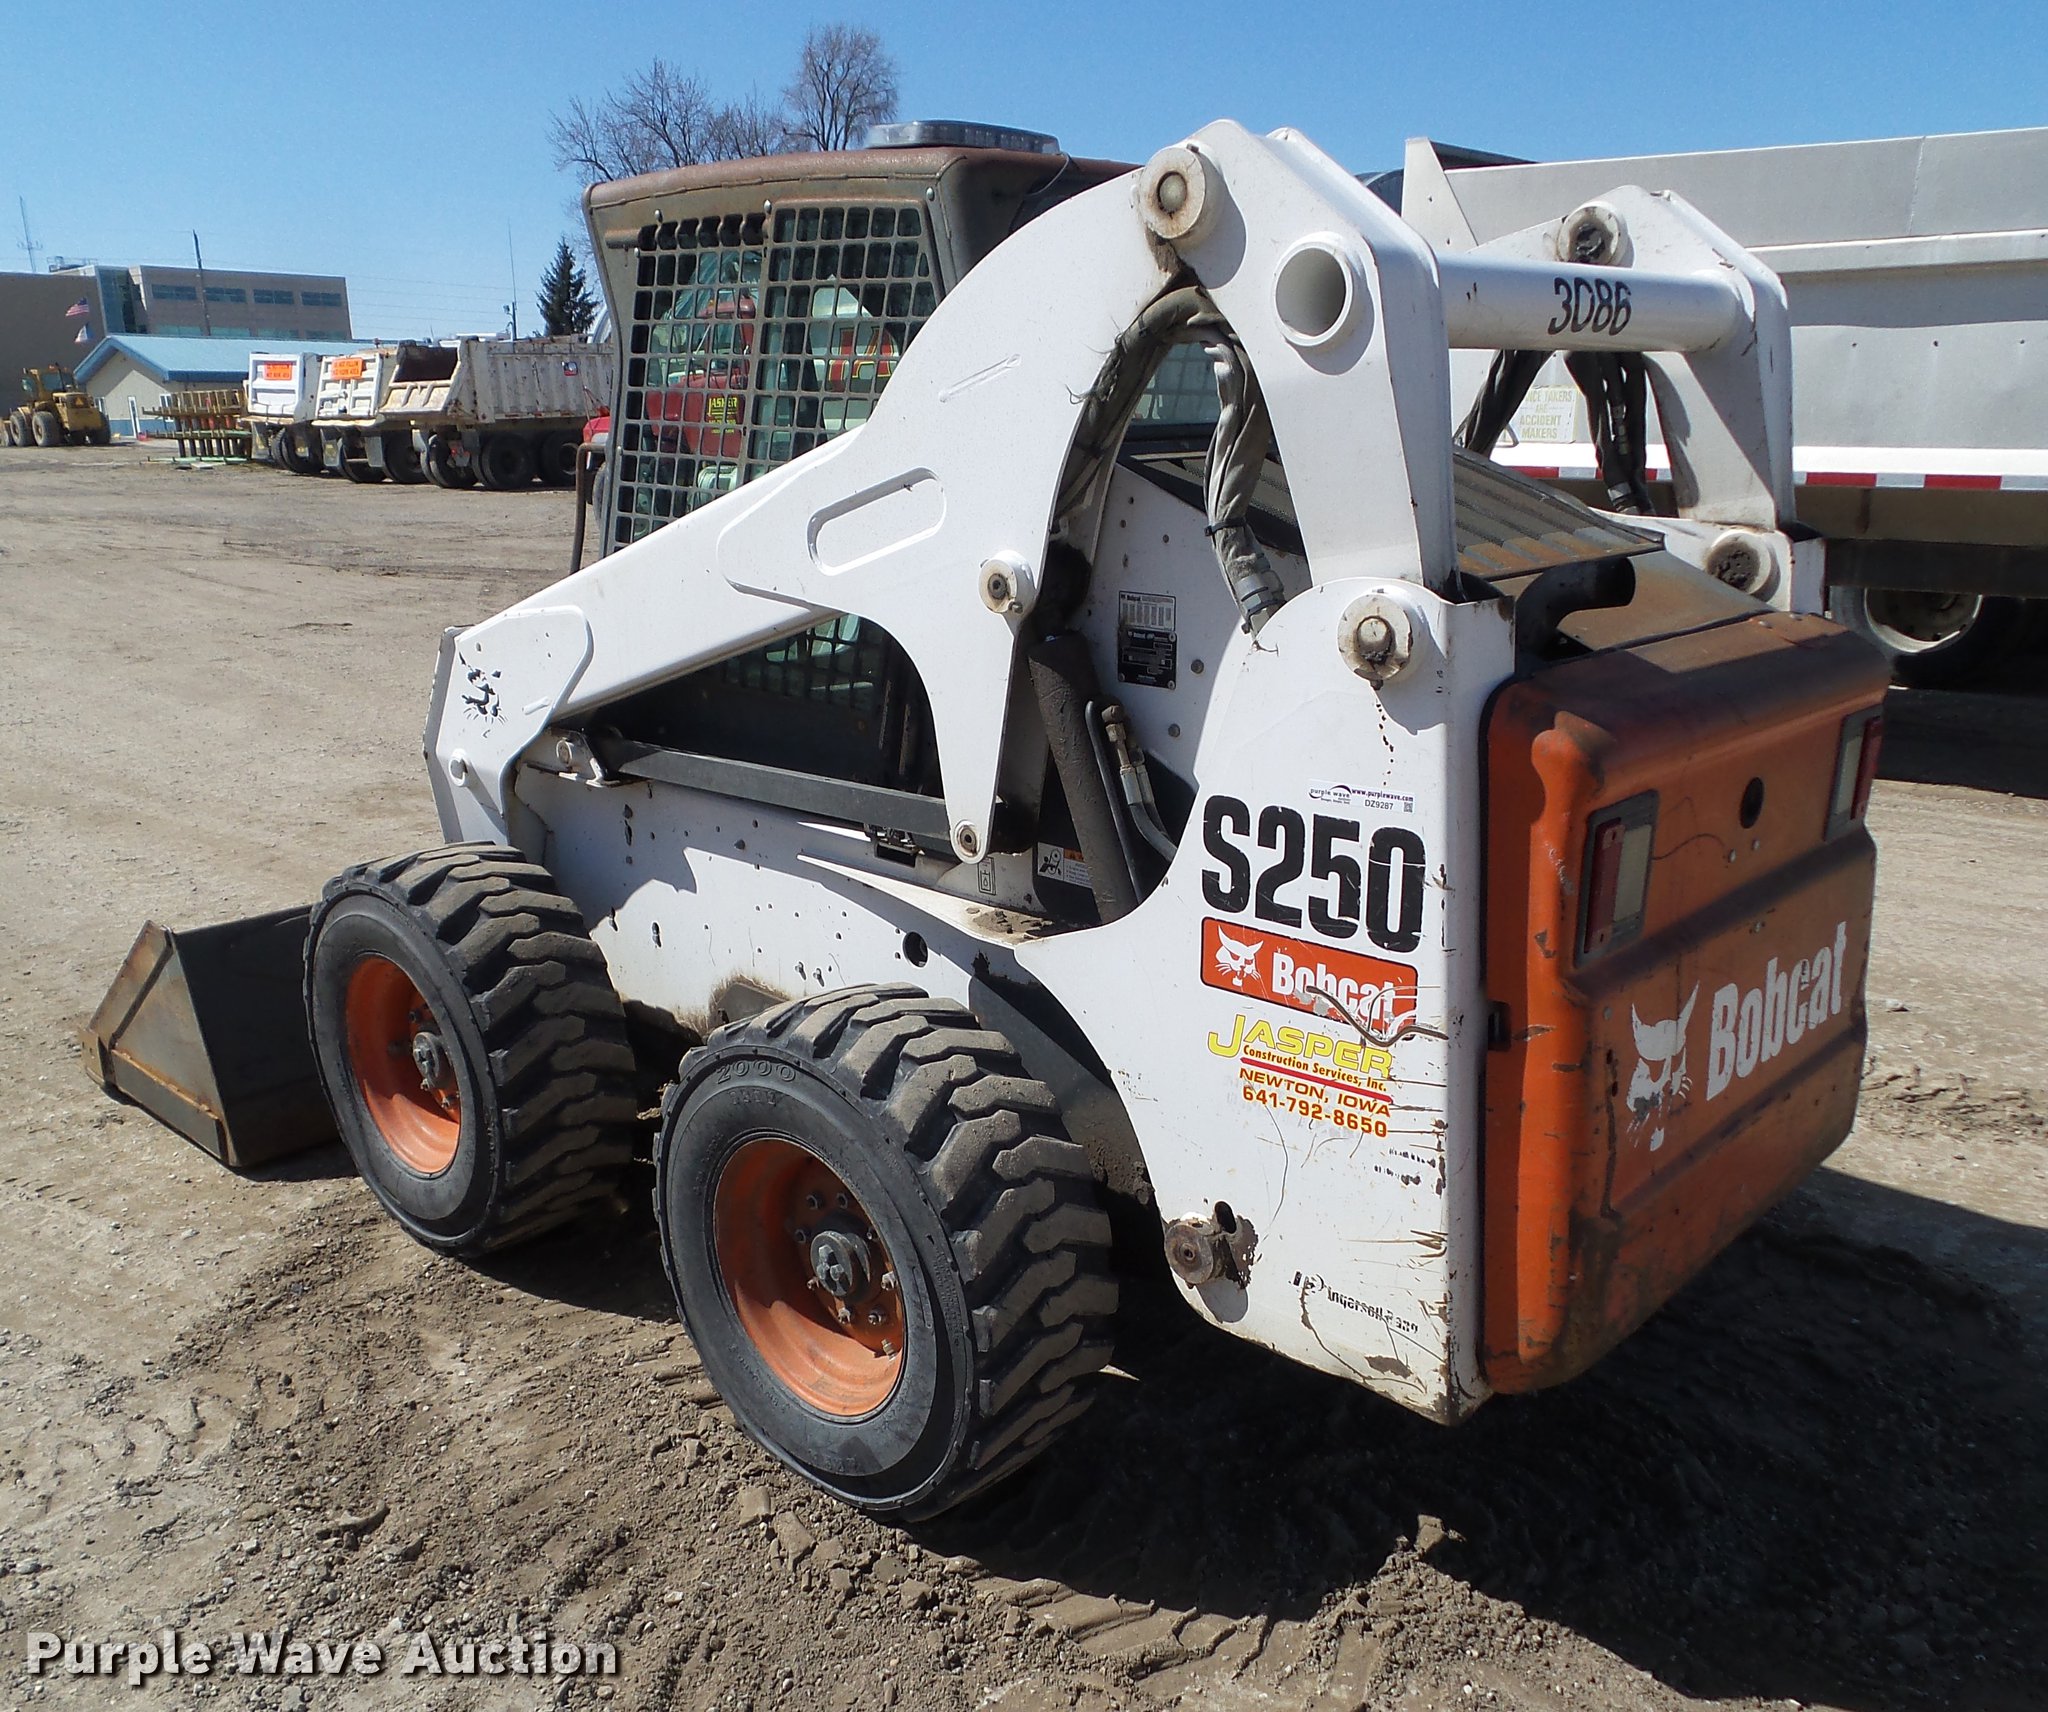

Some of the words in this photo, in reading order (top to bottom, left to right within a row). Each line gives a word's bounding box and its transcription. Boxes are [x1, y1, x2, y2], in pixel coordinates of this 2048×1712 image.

[1544, 390, 1573, 402] TAKERS
[1520, 415, 1562, 426] ACCIDENT
[1521, 427, 1558, 439] MAKERS
[1310, 788, 1331, 797] purple
[1352, 788, 1414, 802] www.purplewave.com
[1364, 799, 1394, 811] DZ9287
[1202, 795, 1426, 953] S250
[1272, 952, 1396, 1025] Bobcat
[1707, 921, 1847, 1101] Bobcat
[1207, 1014, 1393, 1079] JASPER
[1243, 1044, 1309, 1071] Construction
[1313, 1062, 1362, 1087] Services,
[1366, 1076, 1388, 1092] Inc.
[1239, 1067, 1329, 1103] NEWTON,
[1337, 1093, 1391, 1118] IOWA
[1242, 1084, 1388, 1138] 641-792-8650
